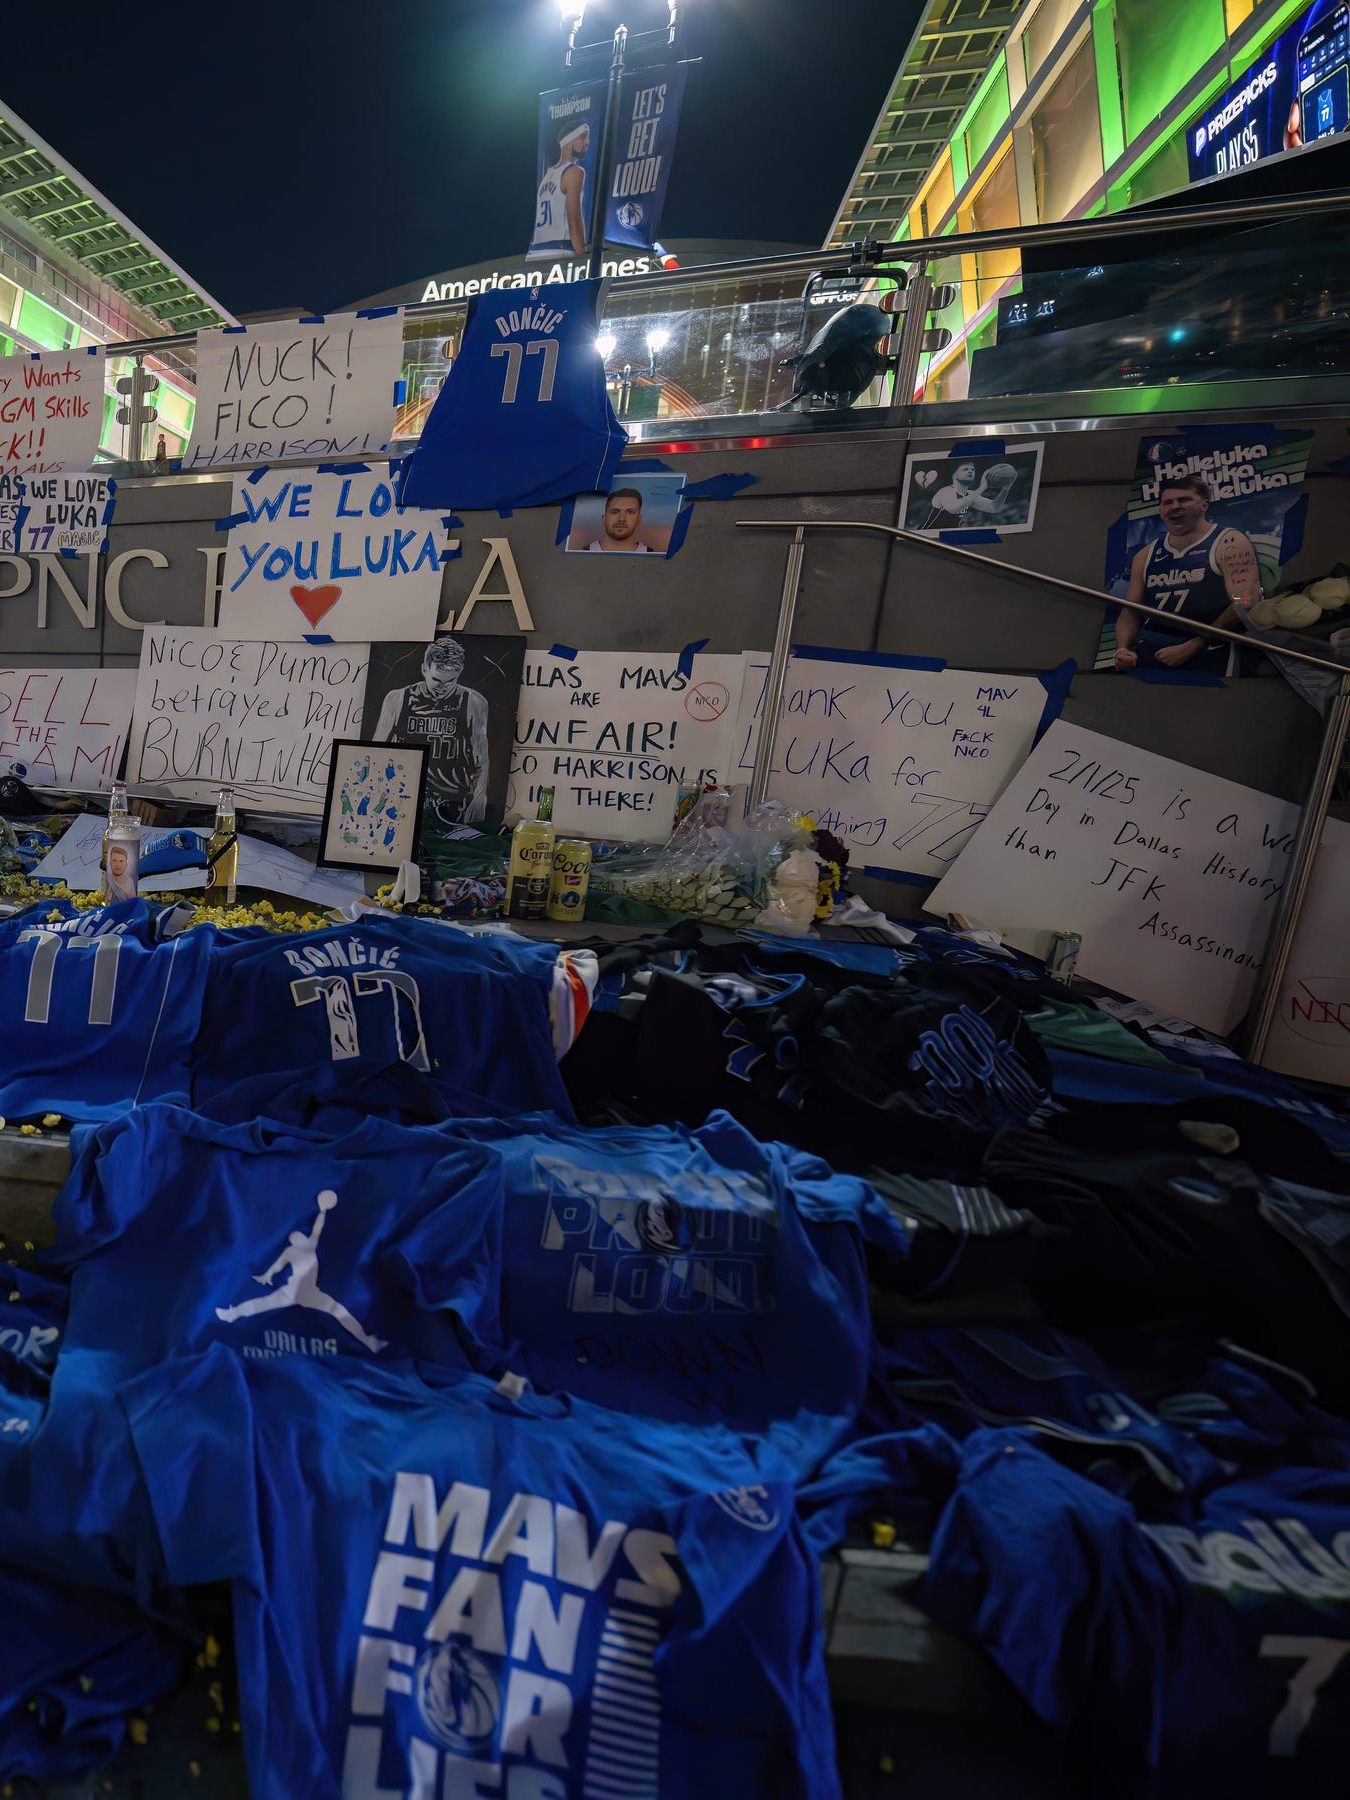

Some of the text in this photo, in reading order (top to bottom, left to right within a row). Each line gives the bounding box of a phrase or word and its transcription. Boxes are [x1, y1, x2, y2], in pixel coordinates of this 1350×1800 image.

[547, 96, 591, 119] THOMPSON
[632, 84, 667, 121] LET'S
[1208, 61, 1277, 141] PRIZEPICKS
[627, 117, 661, 159] GET
[1243, 118, 1259, 164] $5
[612, 155, 663, 198] LOUD!
[421, 256, 650, 303] American Airlnes
[23, 361, 82, 390] Wants
[490, 338, 560, 404] 77
[0, 397, 35, 423] GM
[1154, 444, 1268, 482] Halleluka
[31, 478, 107, 502] WE LOVE
[240, 482, 313, 523] WE
[45, 504, 97, 530] LUKA
[28, 526, 55, 550] 77
[230, 540, 319, 593] YOU
[330, 529, 441, 579] LUKA
[1154, 589, 1190, 613] 77
[521, 665, 687, 691] LLAS MAVS
[976, 687, 1019, 702] MAV
[150, 679, 289, 724] betrayed
[569, 691, 600, 708] ARE
[15, 725, 58, 746] THE
[407, 716, 458, 735] DALLAS
[514, 718, 678, 753] UNFAIR!
[138, 716, 240, 783] BURN
[427, 735, 454, 759] 77
[553, 756, 685, 784] HARRISON
[698, 768, 717, 786] IS
[891, 756, 942, 786] for
[1048, 750, 1140, 805] 2/1/25
[1162, 788, 1192, 821] is
[570, 786, 654, 811] THERE!
[1005, 826, 1057, 861] than
[1025, 788, 1284, 901] Day in Dallas History
[1091, 858, 1167, 902] JFK
[16, 930, 122, 1025] 77
[289, 970, 432, 1072] 77
[263, 1329, 338, 1356] DALLAS
[384, 1471, 682, 1608] MAVS
[363, 1551, 586, 1675] FAN
